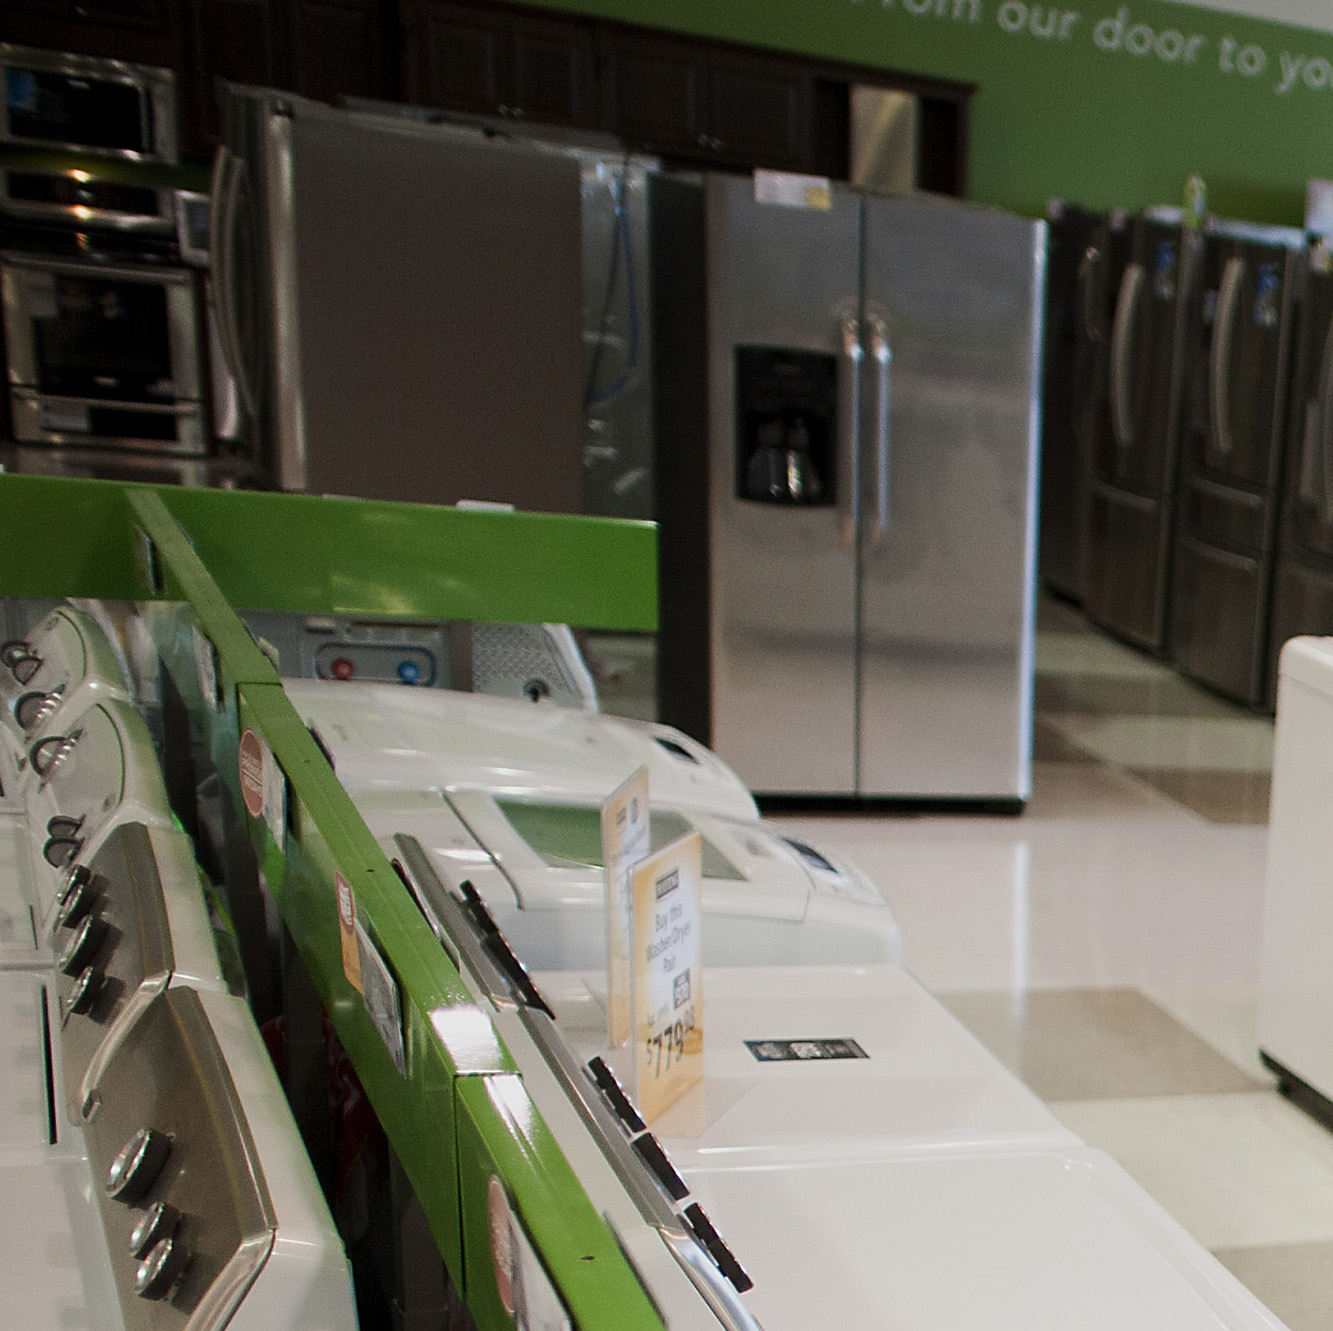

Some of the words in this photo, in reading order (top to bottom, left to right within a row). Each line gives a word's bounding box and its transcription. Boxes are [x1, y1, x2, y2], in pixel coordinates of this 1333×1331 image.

[998, 0, 1081, 40] our
[1093, 7, 1208, 63] door
[1218, 35, 1267, 76] to
